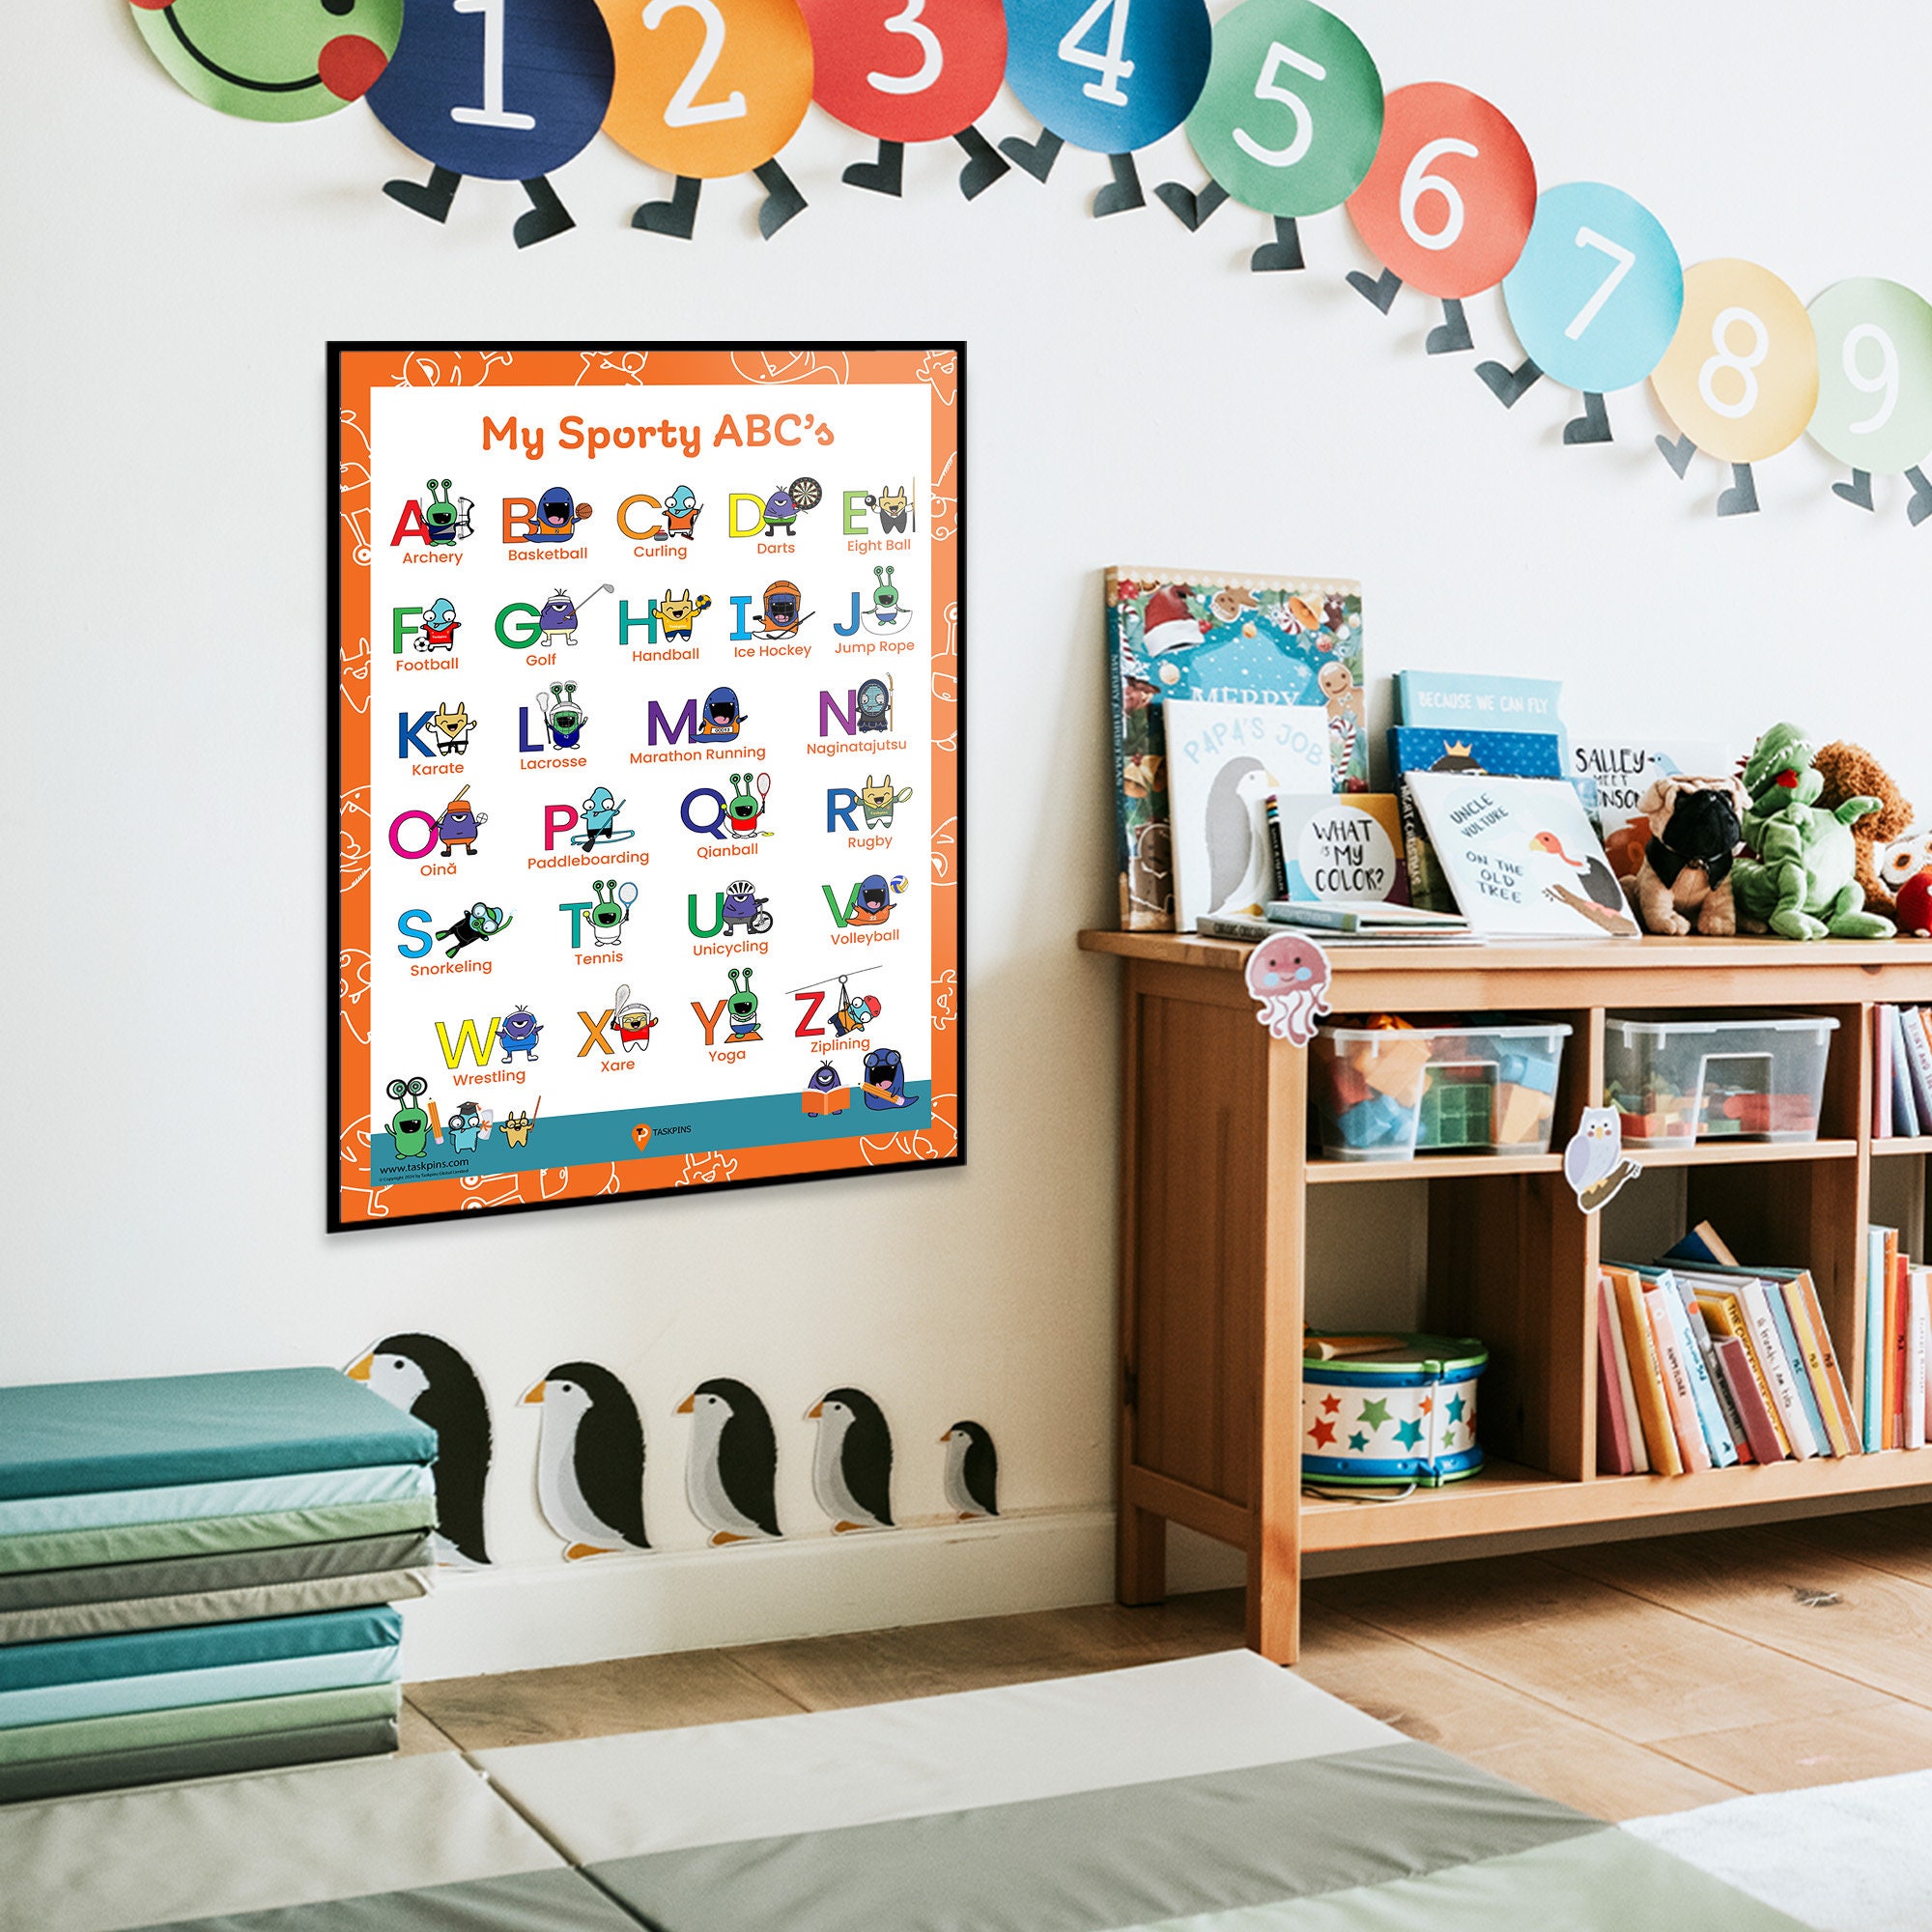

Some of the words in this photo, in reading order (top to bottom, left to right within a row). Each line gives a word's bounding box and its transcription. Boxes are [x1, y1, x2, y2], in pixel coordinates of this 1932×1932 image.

[451, 0, 535, 130] 1
[642, 0, 748, 128] 2
[867, 0, 944, 95] 3
[1058, 0, 1136, 106] 4
[1233, 41, 1326, 168] 5
[1399, 137, 1479, 250] 6
[1564, 225, 1636, 342] 7
[1697, 306, 1770, 419] 8
[1841, 323, 1900, 436] 9
[482, 415, 545, 461] My
[557, 414, 701, 460] Sporty
[712, 412, 835, 448] ABC's
[390, 499, 433, 546] A
[502, 497, 538, 544] B
[616, 494, 662, 540] C
[729, 493, 767, 538] D
[843, 491, 868, 535] E
[402, 551, 464, 567] Archery
[508, 547, 588, 561] Basketball
[633, 544, 688, 560] Curling
[756, 542, 796, 554] Darts
[847, 540, 882, 555] Eight
[886, 539, 911, 551] Ball
[495, 602, 543, 649] G
[619, 599, 657, 645] H
[729, 596, 752, 640] I
[834, 592, 860, 637] J
[393, 607, 423, 654] F
[526, 652, 557, 667] Golf
[632, 648, 699, 662] Handball
[734, 646, 755, 658] Ice
[759, 643, 812, 659] Hockey
[835, 641, 876, 656] Jump
[879, 640, 915, 654] Rope
[395, 657, 459, 672] Football
[820, 689, 857, 737] N
[1417, 691, 1473, 709] BECAUSE
[1475, 695, 1495, 711] WE
[1499, 696, 1524, 713] CAN
[1526, 698, 1548, 715] FLY
[399, 711, 437, 758] K
[519, 707, 544, 753] L
[648, 698, 696, 746] M
[807, 740, 907, 757] Naginatajutsu
[1183, 717, 1266, 764] PAPA'S
[1275, 723, 1323, 765] JOB
[520, 756, 587, 771] Lacrosse
[629, 750, 701, 764] Marathon
[705, 746, 766, 761] Running
[1576, 748, 1645, 774] SALLEY
[412, 762, 465, 777] Karate
[680, 787, 728, 840] Q
[827, 788, 859, 833] R
[1449, 792, 1494, 825] UNCLE
[388, 810, 439, 860] O
[545, 804, 579, 851] P
[1313, 820, 1373, 842] WHAT
[1461, 807, 1509, 838] VULTURE
[696, 842, 758, 860] Qianball
[847, 835, 894, 851] Rugby
[527, 851, 649, 868] Paddleboarding
[1466, 850, 1489, 866] ON
[1495, 858, 1523, 877] THE
[1316, 867, 1384, 892] COLOR?
[1480, 868, 1515, 887] OLD
[1476, 880, 1521, 904] TREE
[688, 892, 724, 939] U
[821, 883, 863, 928] V
[397, 908, 433, 958] S
[559, 902, 593, 949] T
[830, 928, 899, 947] Volleyball
[574, 950, 624, 966] Tennis
[693, 940, 769, 957] Unicycling
[410, 959, 493, 977] Snorkeling
[691, 999, 728, 1046] Y
[795, 991, 825, 1037] Z
[435, 1017, 501, 1069] W
[577, 1009, 615, 1058] X
[810, 1037, 870, 1054] Ziplining
[601, 1060, 636, 1072] Xare
[708, 1050, 747, 1065] Yoga
[452, 1069, 526, 1086] Wrestling
[653, 1125, 692, 1136] TASKPINS
[380, 1158, 469, 1175] www.taskpins.com
